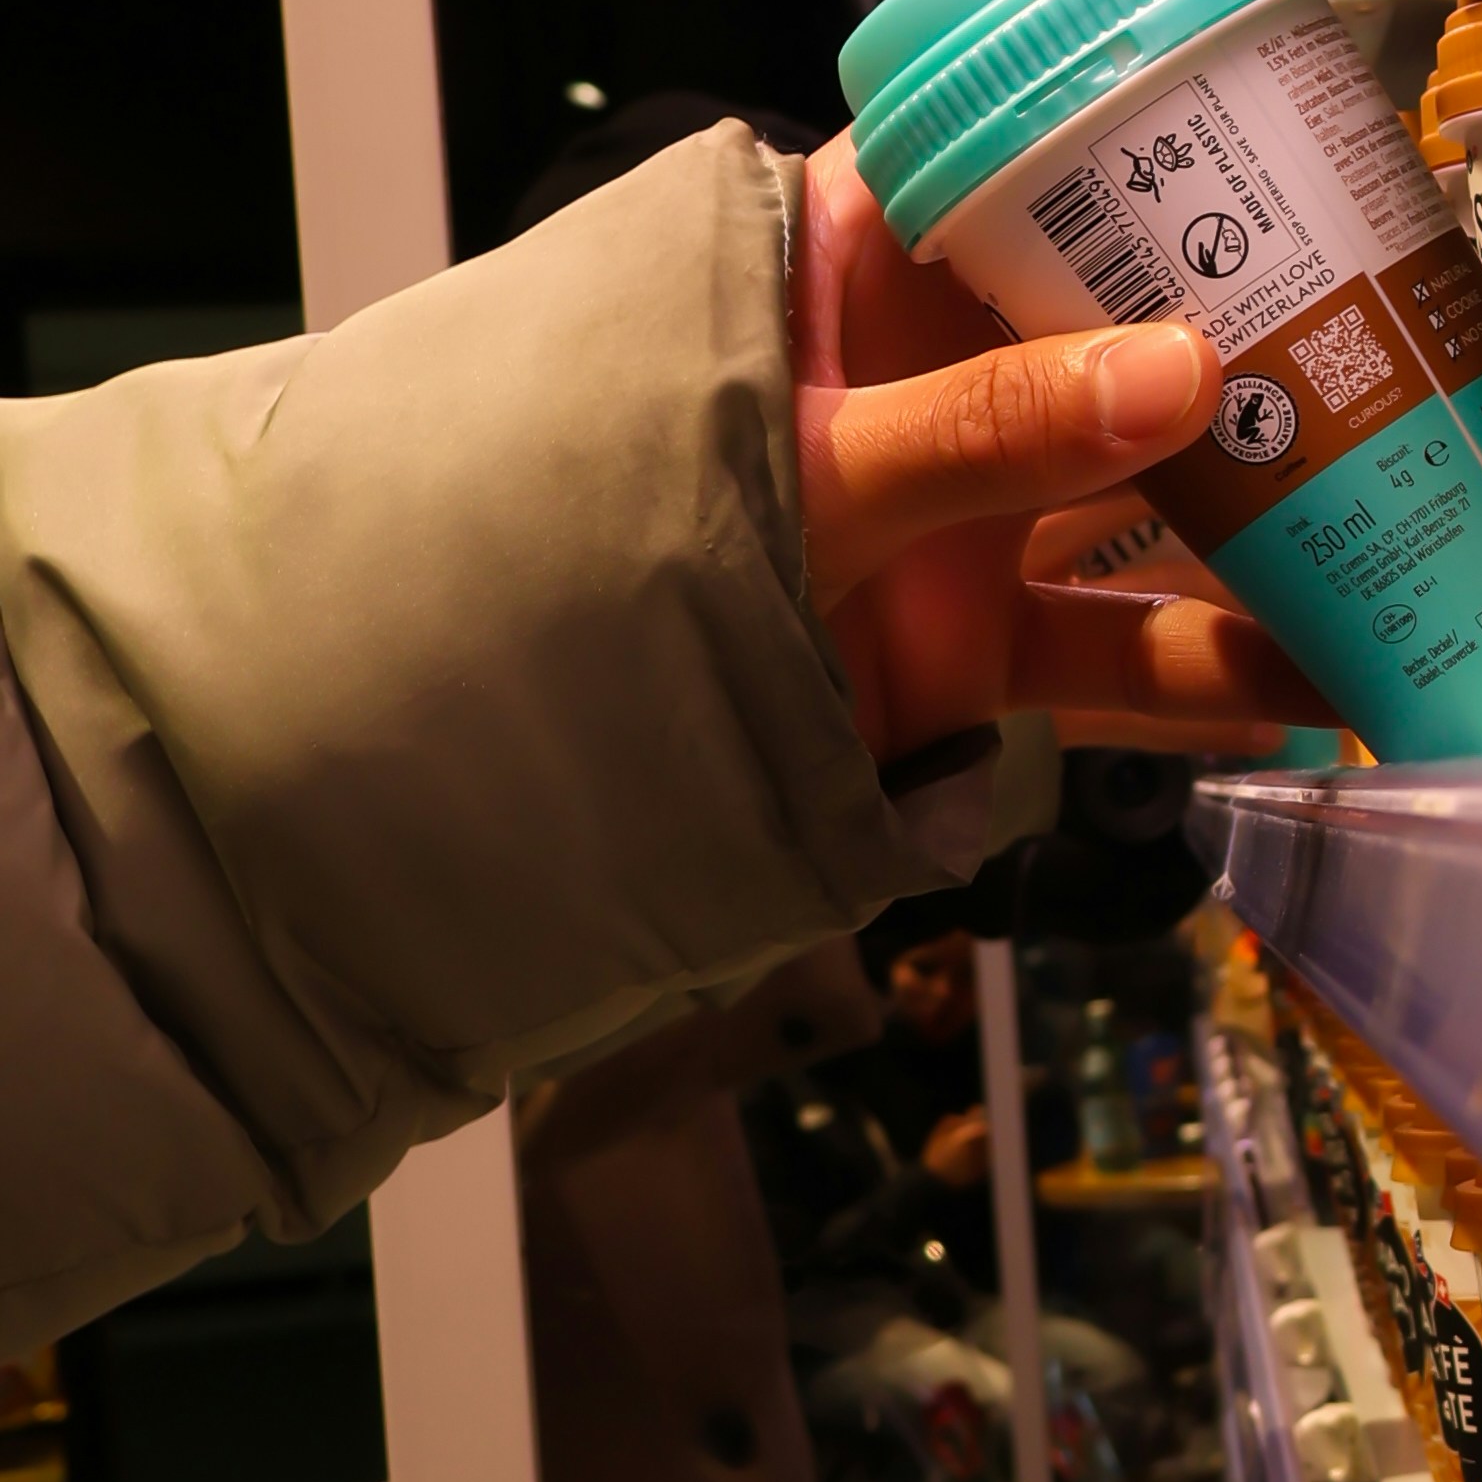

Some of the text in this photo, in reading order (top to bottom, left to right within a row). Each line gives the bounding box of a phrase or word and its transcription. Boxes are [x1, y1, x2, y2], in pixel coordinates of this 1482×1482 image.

[1187, 113, 1275, 234] MADE OF PLASTIC
[1192, 73, 1313, 246] STOP LITTERING SAVE OUR PLANET
[1201, 248, 1327, 341] ADE WITH LOVE
[1217, 268, 1336, 356] SWITZERLAND
[1236, 380, 1285, 403] ALLIANCE
[1348, 385, 1403, 429] CURIOUS?
[1376, 442, 1414, 473] Biscuit:
[1301, 499, 1377, 568] 250 ml
[1339, 550, 1369, 576] Cremo
[1428, 481, 1468, 514] Fribourg
[1397, 554, 1418, 576] Bad
[1415, 523, 1466, 562] Wörishofen
[1350, 564, 1380, 590] Cremo
